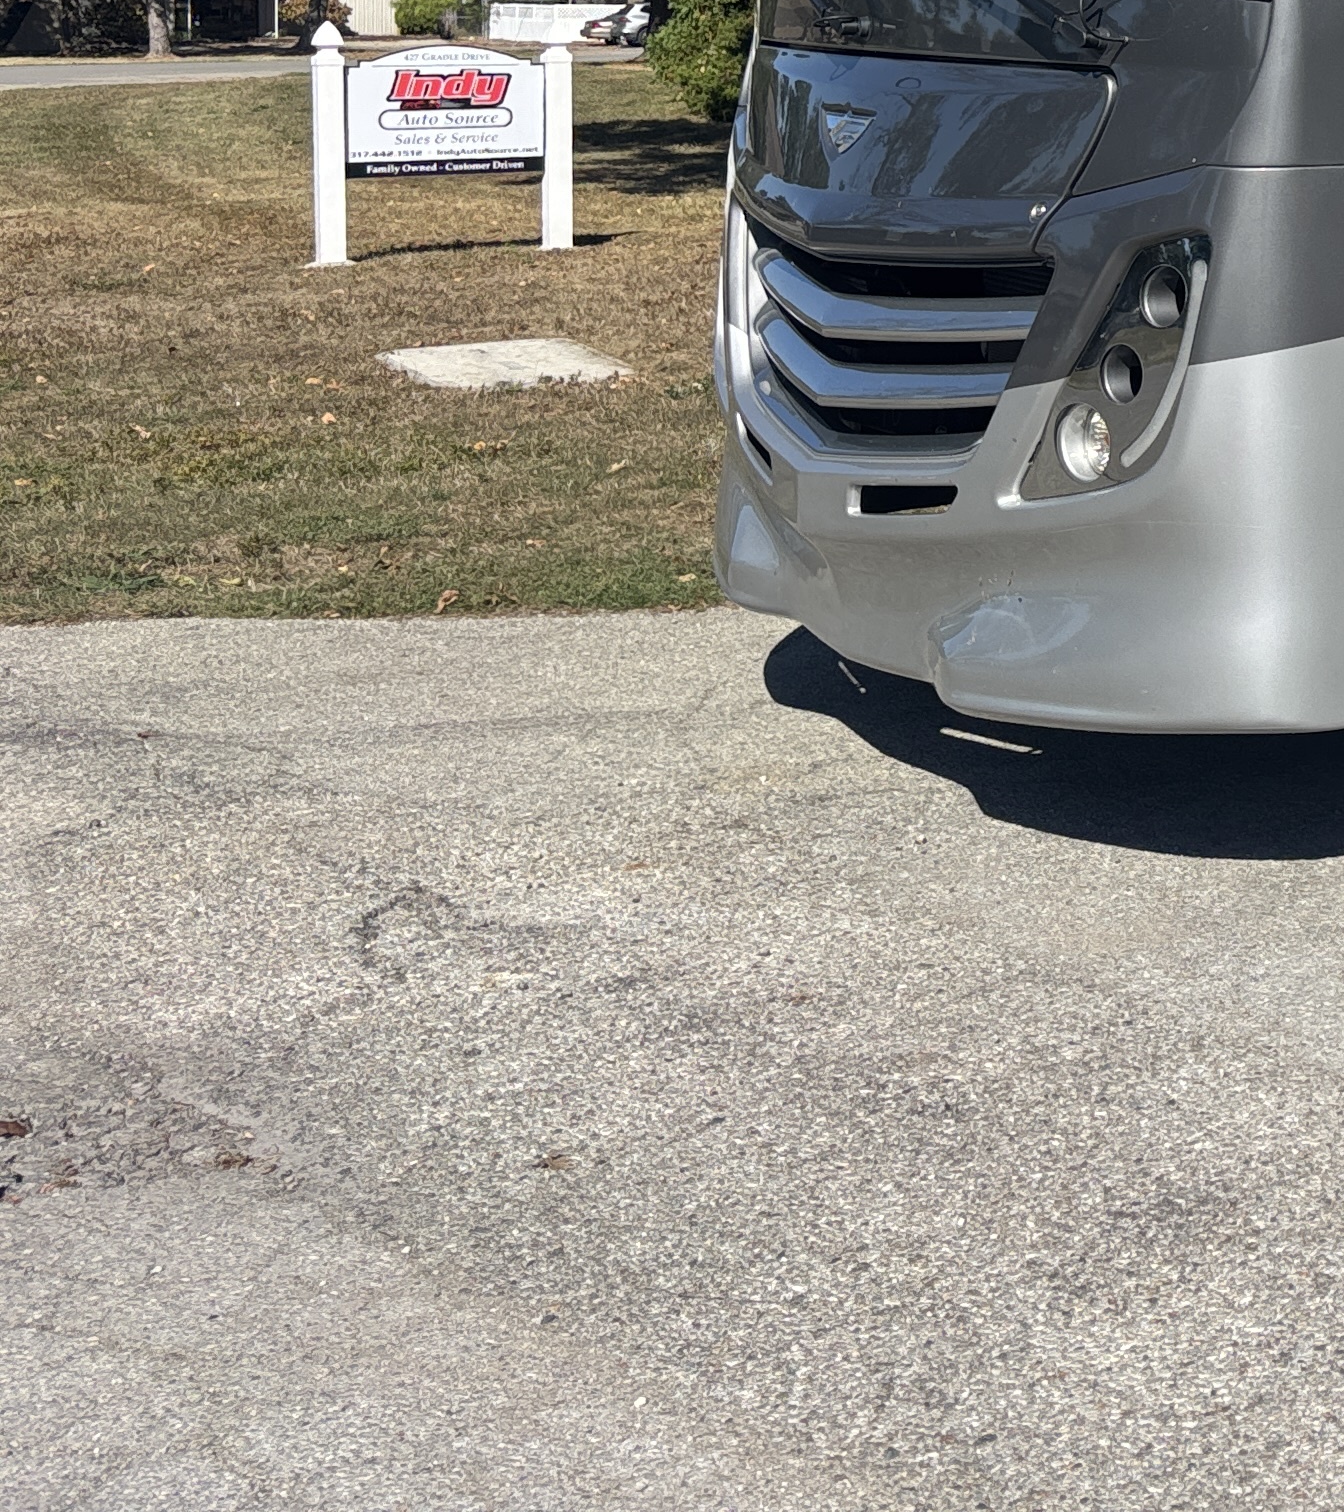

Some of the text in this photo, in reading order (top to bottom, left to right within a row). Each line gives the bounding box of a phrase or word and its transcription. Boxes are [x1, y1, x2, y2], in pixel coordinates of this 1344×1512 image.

[386, 69, 512, 107] Indy
[397, 112, 499, 126] Auto Source
[394, 131, 499, 146] Sales & Service
[366, 163, 400, 175] Family
[402, 162, 438, 173] Owned
[445, 161, 491, 171] Customer
[492, 159, 525, 170] Driven
